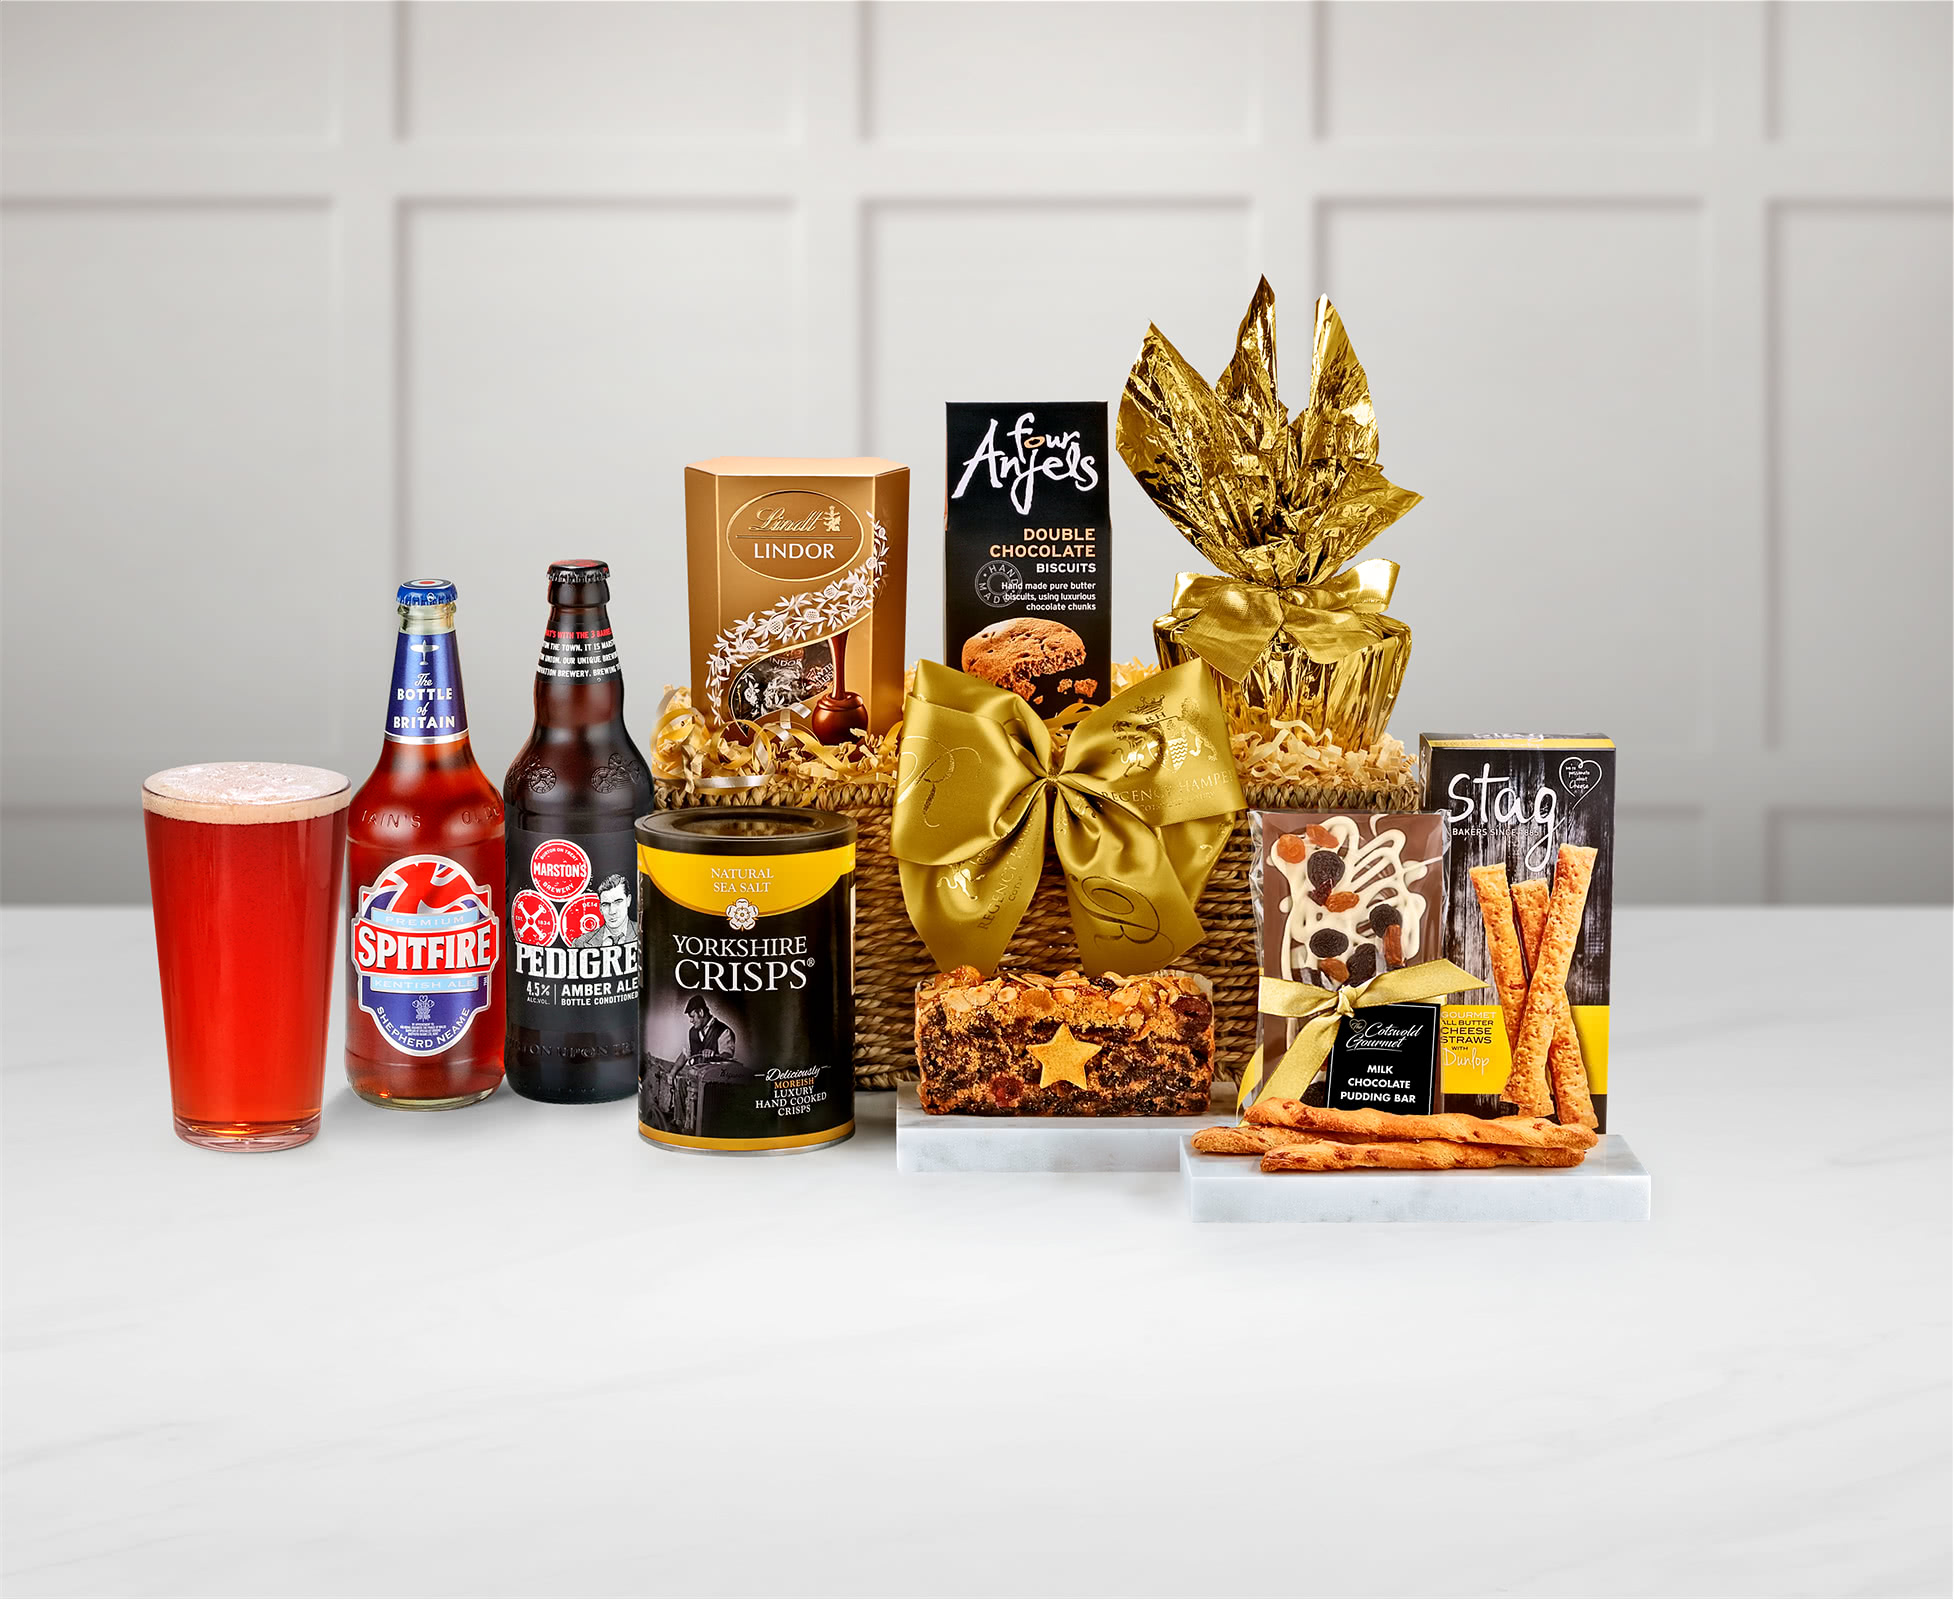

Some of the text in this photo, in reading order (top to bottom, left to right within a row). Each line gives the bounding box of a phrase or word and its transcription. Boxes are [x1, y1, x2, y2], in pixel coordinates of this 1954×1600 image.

[748, 507, 824, 532] Lindt
[1024, 528, 1096, 540] DOUBLE
[754, 543, 835, 559] LINDOR
[990, 545, 1096, 558] CHOCOLATE
[1036, 563, 1096, 573] BISCUITS
[1001, 582, 1096, 591] Hand made pure butter
[1006, 593, 1096, 602] biscuits, using luxurious
[590, 630, 595, 638] 3
[594, 643, 601, 651] IS
[577, 656, 602, 664] UNIQUE
[415, 673, 432, 686] The
[397, 688, 452, 700] BOTTLE
[416, 702, 430, 716] of
[394, 716, 455, 728] BRITAIN
[1452, 828, 1487, 836] BAKERS
[1490, 828, 1516, 836] SINCE
[534, 862, 587, 877] MARSTON'S
[711, 868, 774, 879] NATURAL
[543, 882, 574, 893] BREWERY
[713, 882, 771, 892] SEA SALT
[384, 914, 464, 927] PREMIUM
[358, 924, 491, 970] SPITFIRE
[673, 934, 807, 957] YORKSHIRE
[515, 941, 638, 979] PEDIGRE
[375, 979, 441, 989] KENTISH
[448, 979, 474, 988] ALE
[527, 977, 638, 996] 4.5% AMBER ALE
[561, 998, 591, 1006] BOTTLE
[594, 991, 638, 1006] CONDITIONED
[377, 1006, 470, 1048] SHEPHERD NEAME
[1365, 1022, 1424, 1038] Cotswold
[1441, 1027, 1492, 1035] CHEESE
[1346, 1033, 1407, 1050] Gourmet
[1440, 1036, 1492, 1044] STRAWS
[1442, 1047, 1489, 1076] Dunlop
[765, 1065, 820, 1081] Deliciously
[1367, 1064, 1393, 1074] MILK
[774, 1077, 814, 1089] MOREISH
[1347, 1078, 1411, 1089] CHOCOLATE
[774, 1086, 814, 1098] LUXURY
[1340, 1092, 1416, 1103] PUDDING BAR
[755, 1092, 827, 1108] HAND COOKED
[778, 1105, 811, 1116] CRISPS
